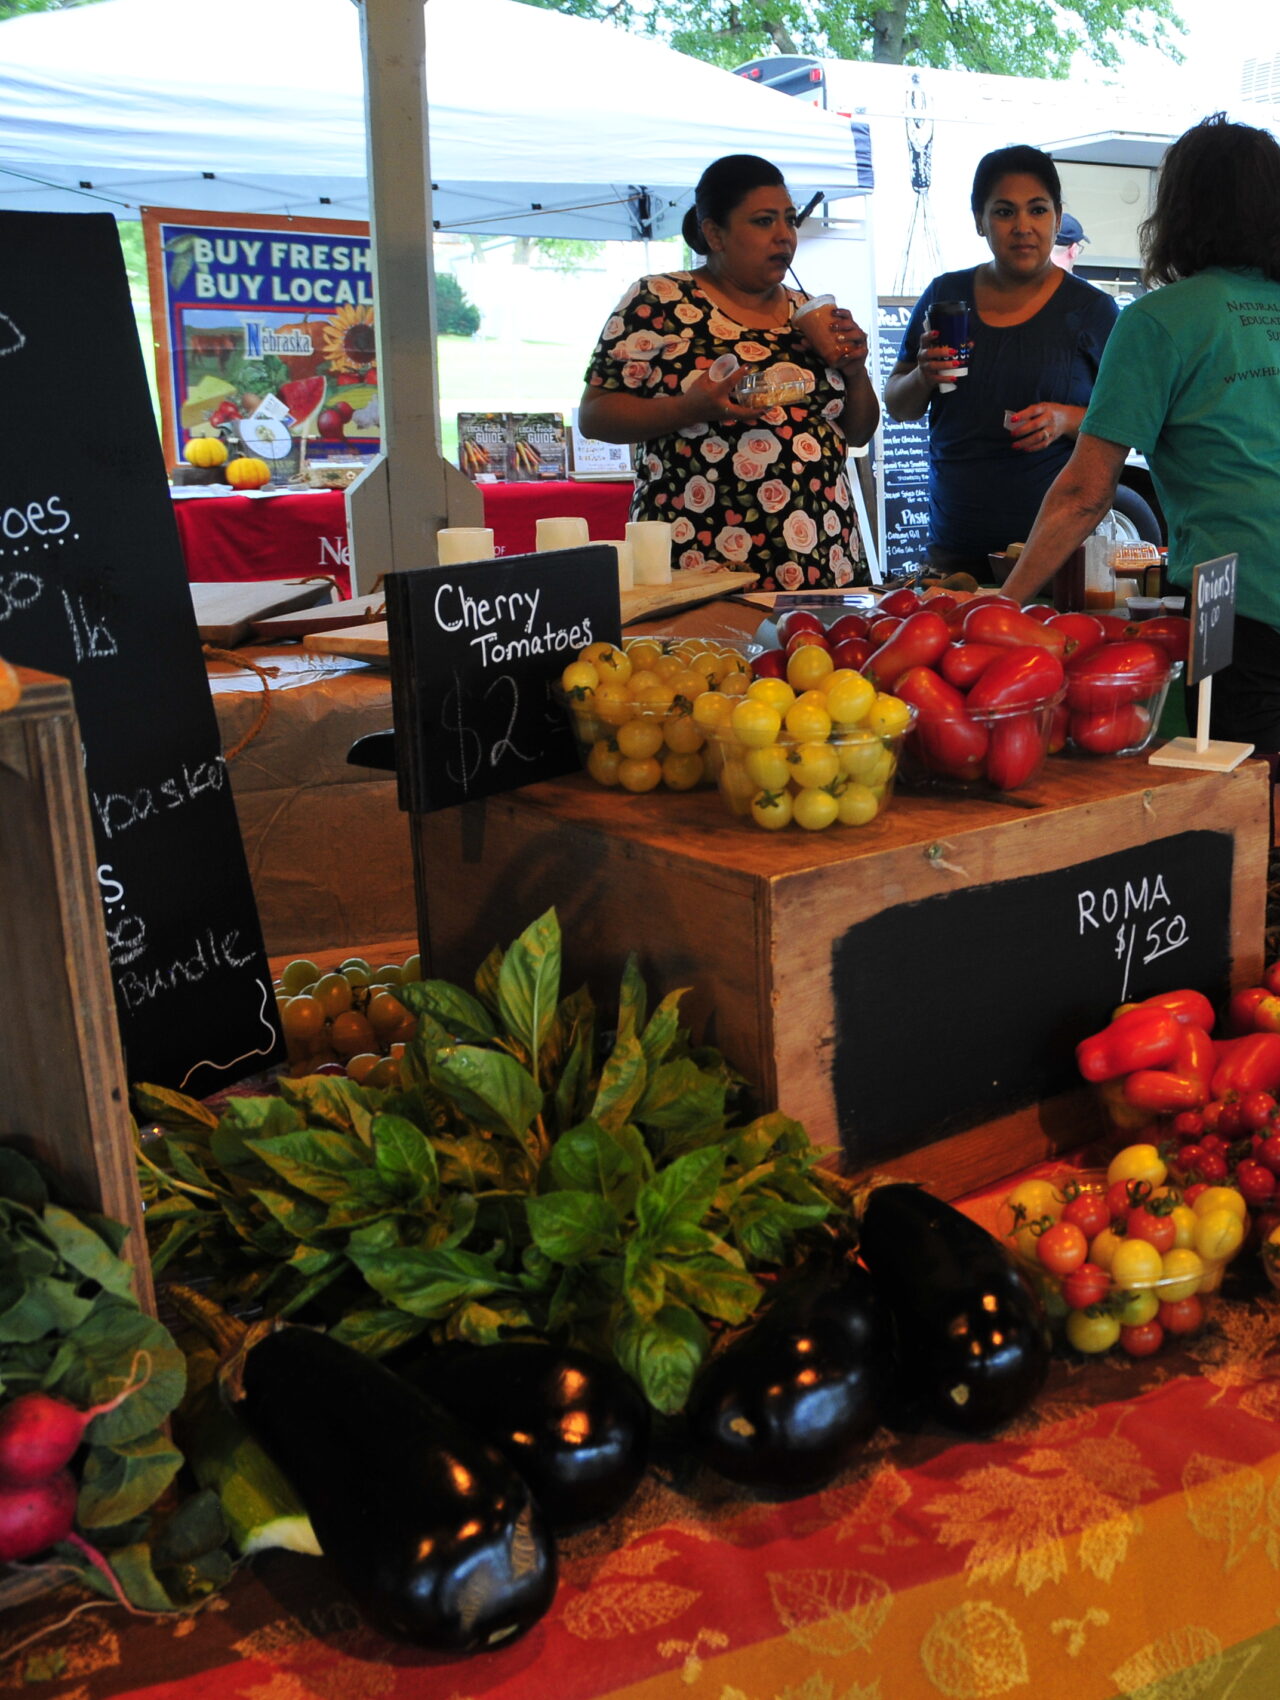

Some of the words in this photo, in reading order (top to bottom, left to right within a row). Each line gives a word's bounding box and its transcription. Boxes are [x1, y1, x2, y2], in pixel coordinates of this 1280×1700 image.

[193, 238, 263, 266] BUY
[270, 241, 372, 272] FRESH
[195, 272, 264, 300] BUY
[272, 278, 374, 304] LOCAL
[245, 320, 312, 358] Nebraska
[475, 432, 504, 443] GUIDE
[528, 432, 556, 443] GUIDE
[318, 536, 351, 566] Ne
[434, 583, 541, 634] Cherry
[469, 617, 594, 668] Tomatoes
[1078, 874, 1172, 935] ROMA
[119, 927, 257, 1010] Bundle
